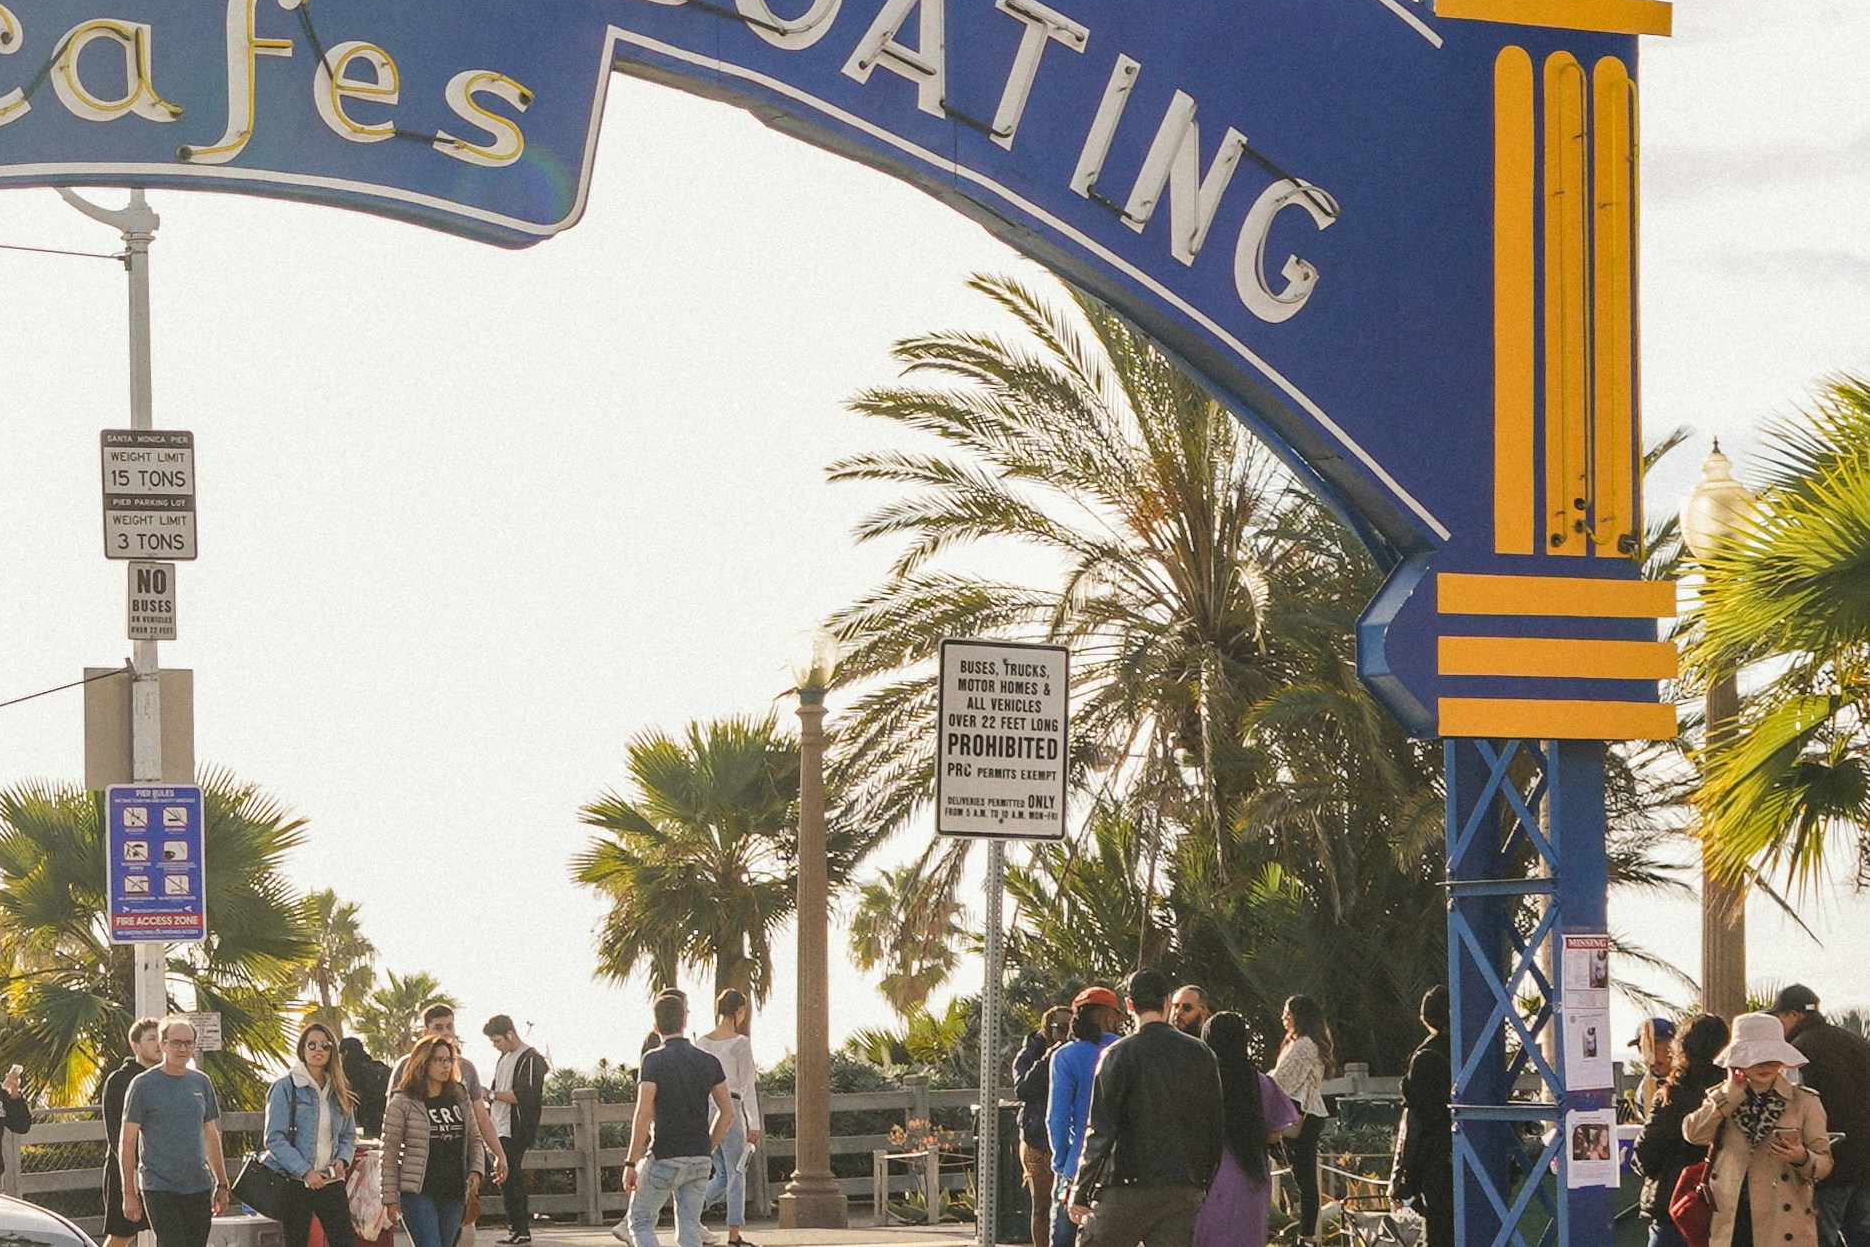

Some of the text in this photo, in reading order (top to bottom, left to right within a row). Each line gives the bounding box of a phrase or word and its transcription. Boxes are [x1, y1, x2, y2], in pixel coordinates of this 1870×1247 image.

[107, 434, 188, 444] SANTA MONICA PIER
[110, 451, 185, 462] WEIGHT LIMIT
[111, 469, 186, 487] 15 TONS
[112, 498, 131, 506] PIER
[112, 515, 187, 526] WEIGHT LIMIT
[117, 533, 184, 550] 3 TONS
[137, 568, 167, 594] NO
[132, 599, 172, 613] BUSES
[960, 660, 1050, 679] BUSES, TRUCKS,
[958, 678, 1051, 696] MOTOR HOMES &
[967, 697, 1042, 713] ALL VEHICLES
[948, 713, 1059, 732] OVER 22 FEET LONG
[947, 732, 1058, 760] PROHIBITED
[977, 767, 1017, 780] PERMITS
[1020, 769, 1057, 781] EXEMPT
[135, 789, 175, 798] PIER RULES
[947, 794, 1056, 809] DELIVERIES PERMITTED ONLY
[944, 807, 964, 817] FROM
[991, 809, 999, 818] TO
[1028, 811, 1058, 820] MON-FRI
[116, 915, 199, 926] FIRE ACCESS ZONE
[1568, 938, 1607, 948] MISSING
